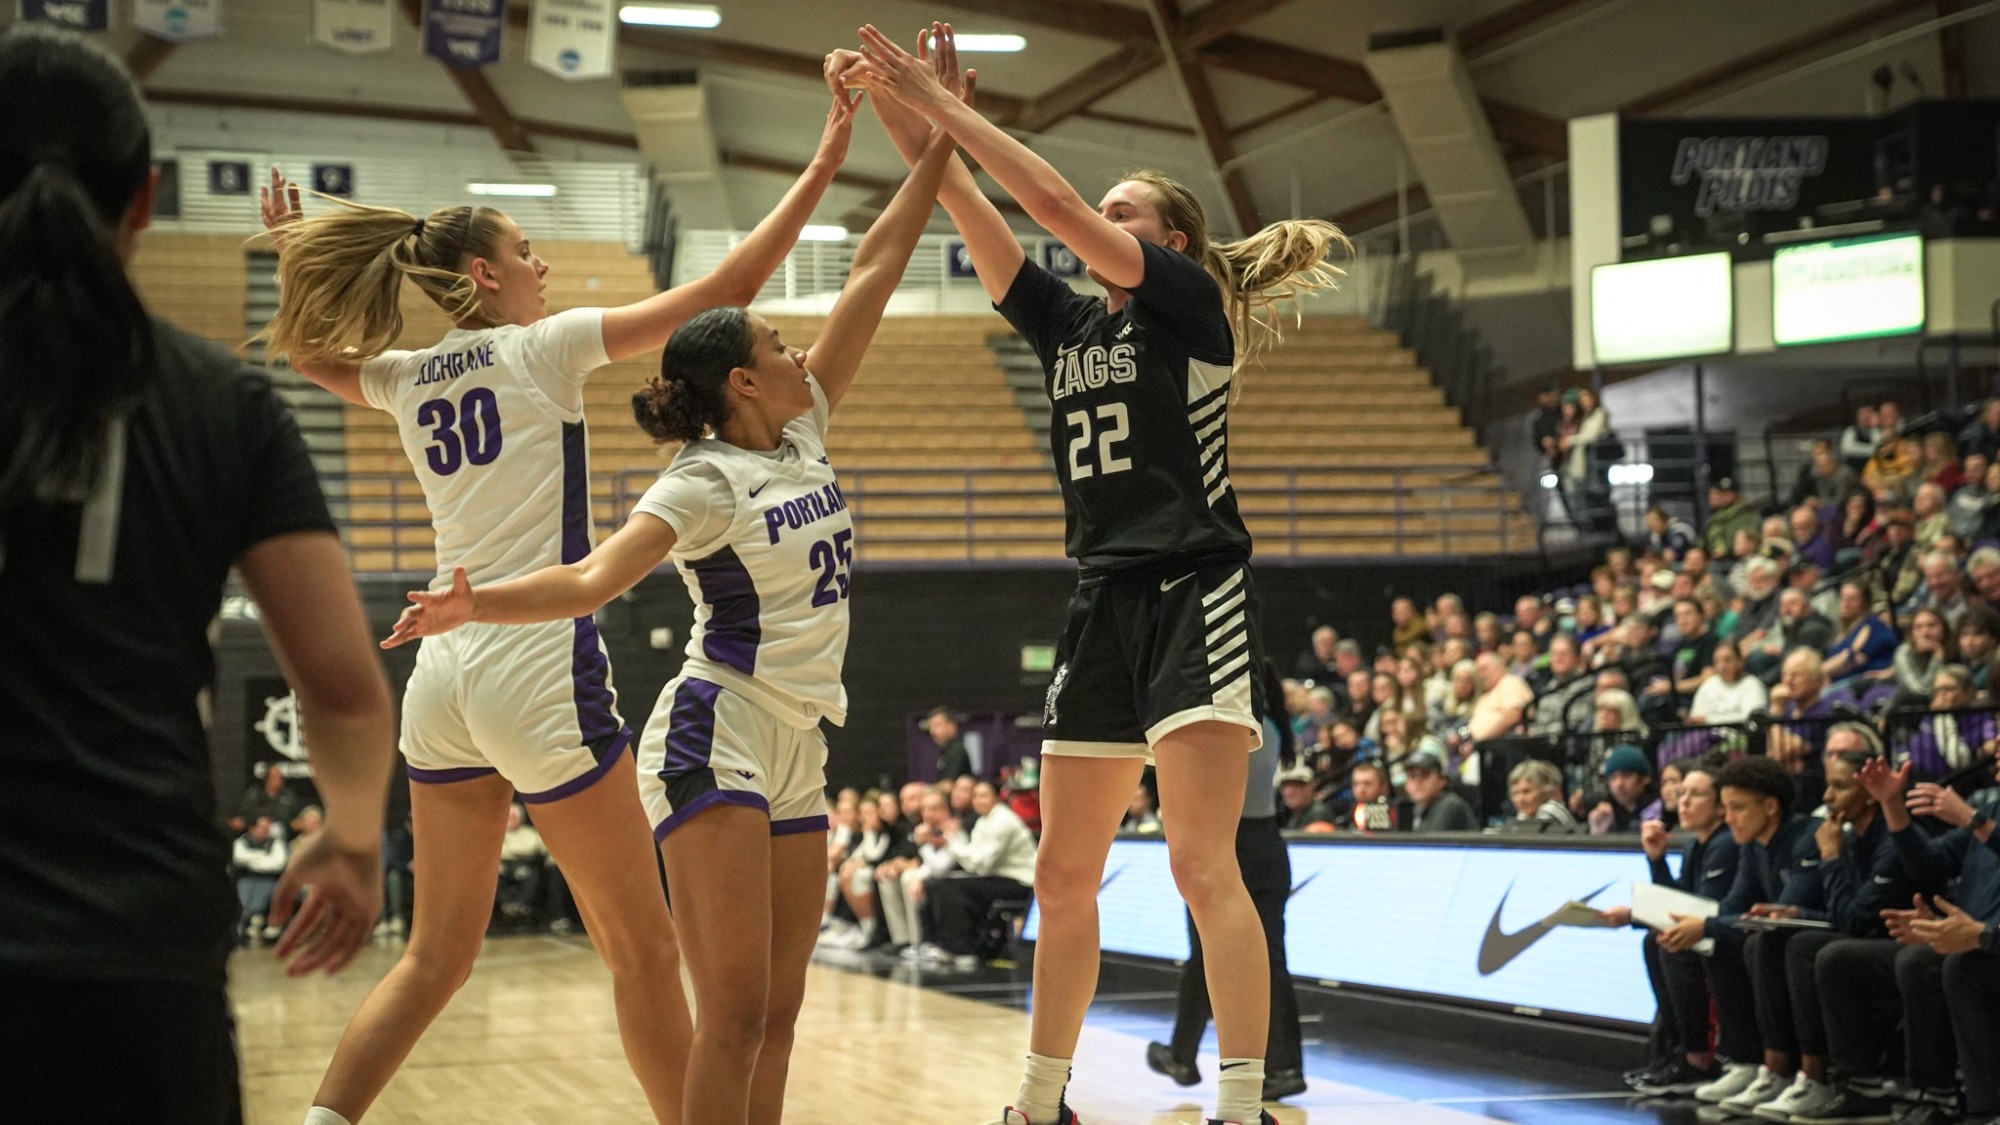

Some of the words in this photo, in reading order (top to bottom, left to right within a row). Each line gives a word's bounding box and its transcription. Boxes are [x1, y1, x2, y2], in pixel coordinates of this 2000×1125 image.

[1050, 246, 1078, 273] 10
[1052, 343, 1138, 401] ZAGS
[417, 386, 503, 477] 30
[1066, 401, 1133, 481] 22
[763, 480, 848, 546] PORTLAN
[809, 528, 852, 608] 25
